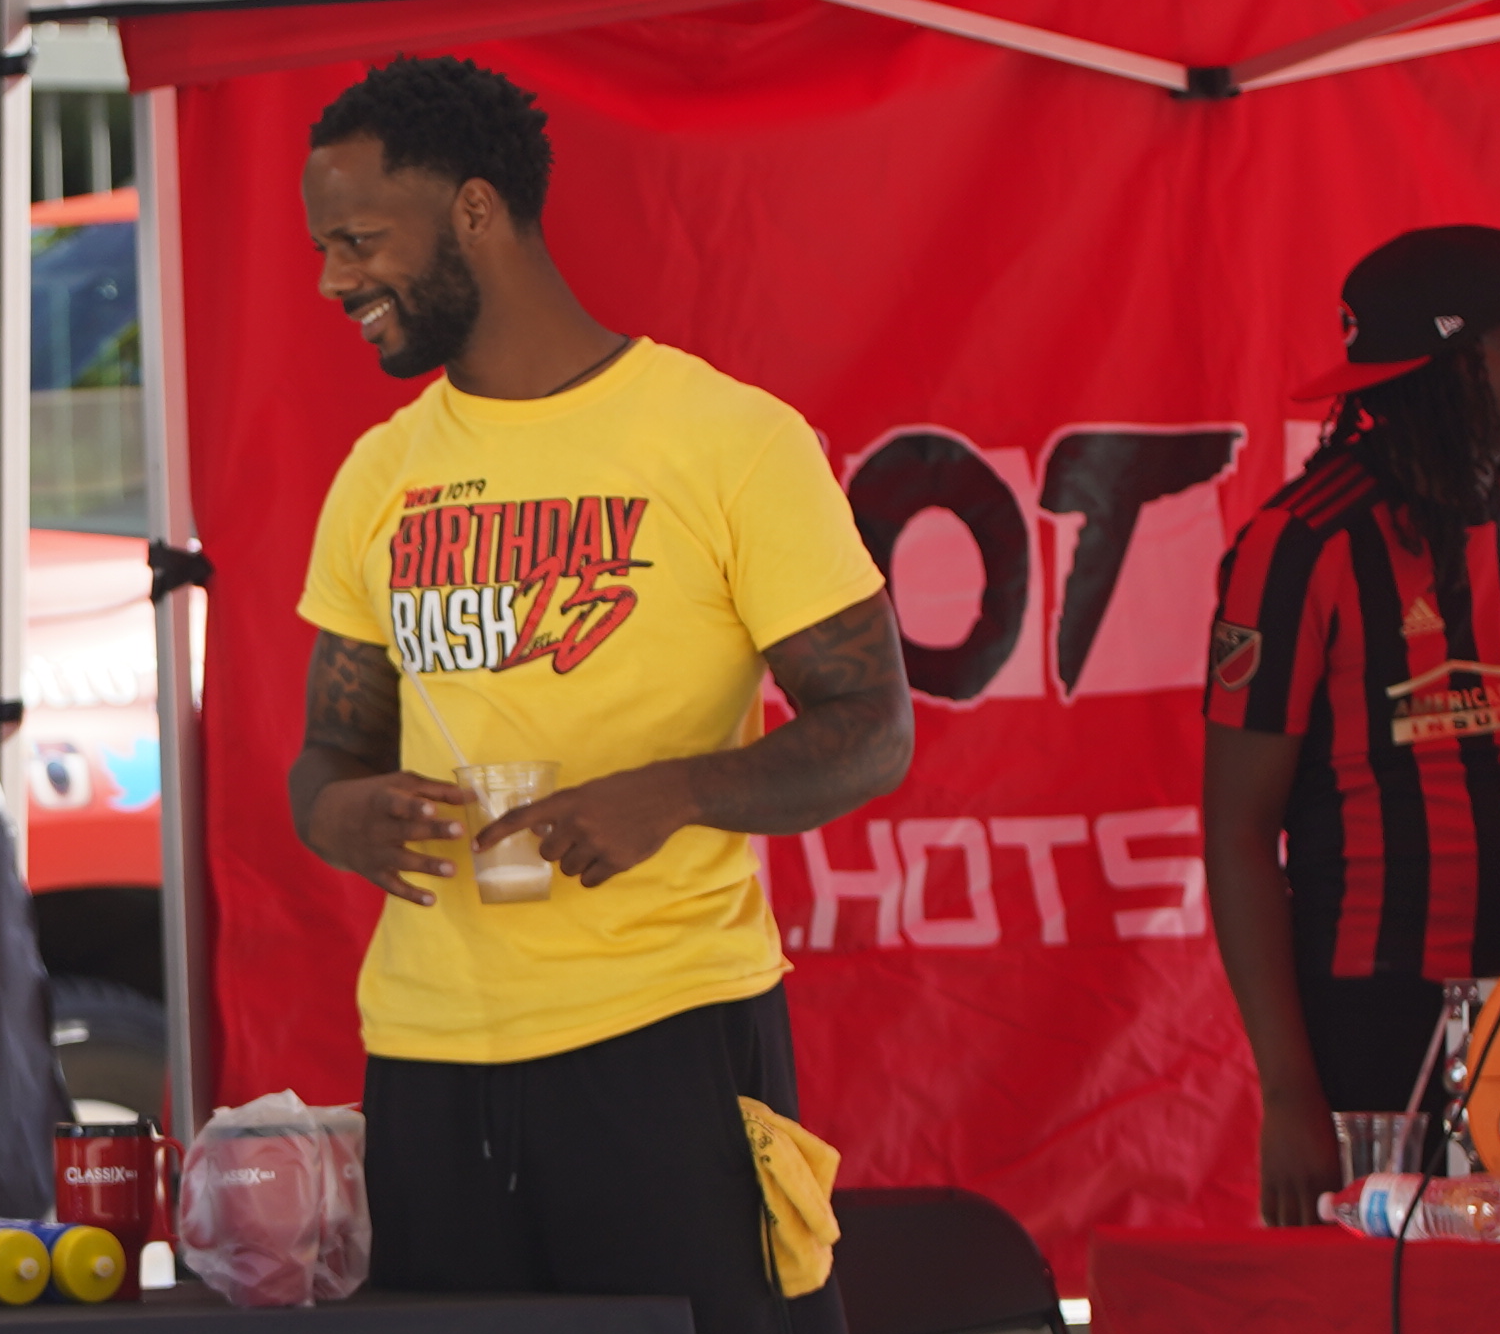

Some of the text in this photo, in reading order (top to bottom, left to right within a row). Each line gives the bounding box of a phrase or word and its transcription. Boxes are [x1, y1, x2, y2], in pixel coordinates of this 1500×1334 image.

[390, 496, 648, 590] BIRTHDAY
[391, 556, 654, 675] BASH 25
